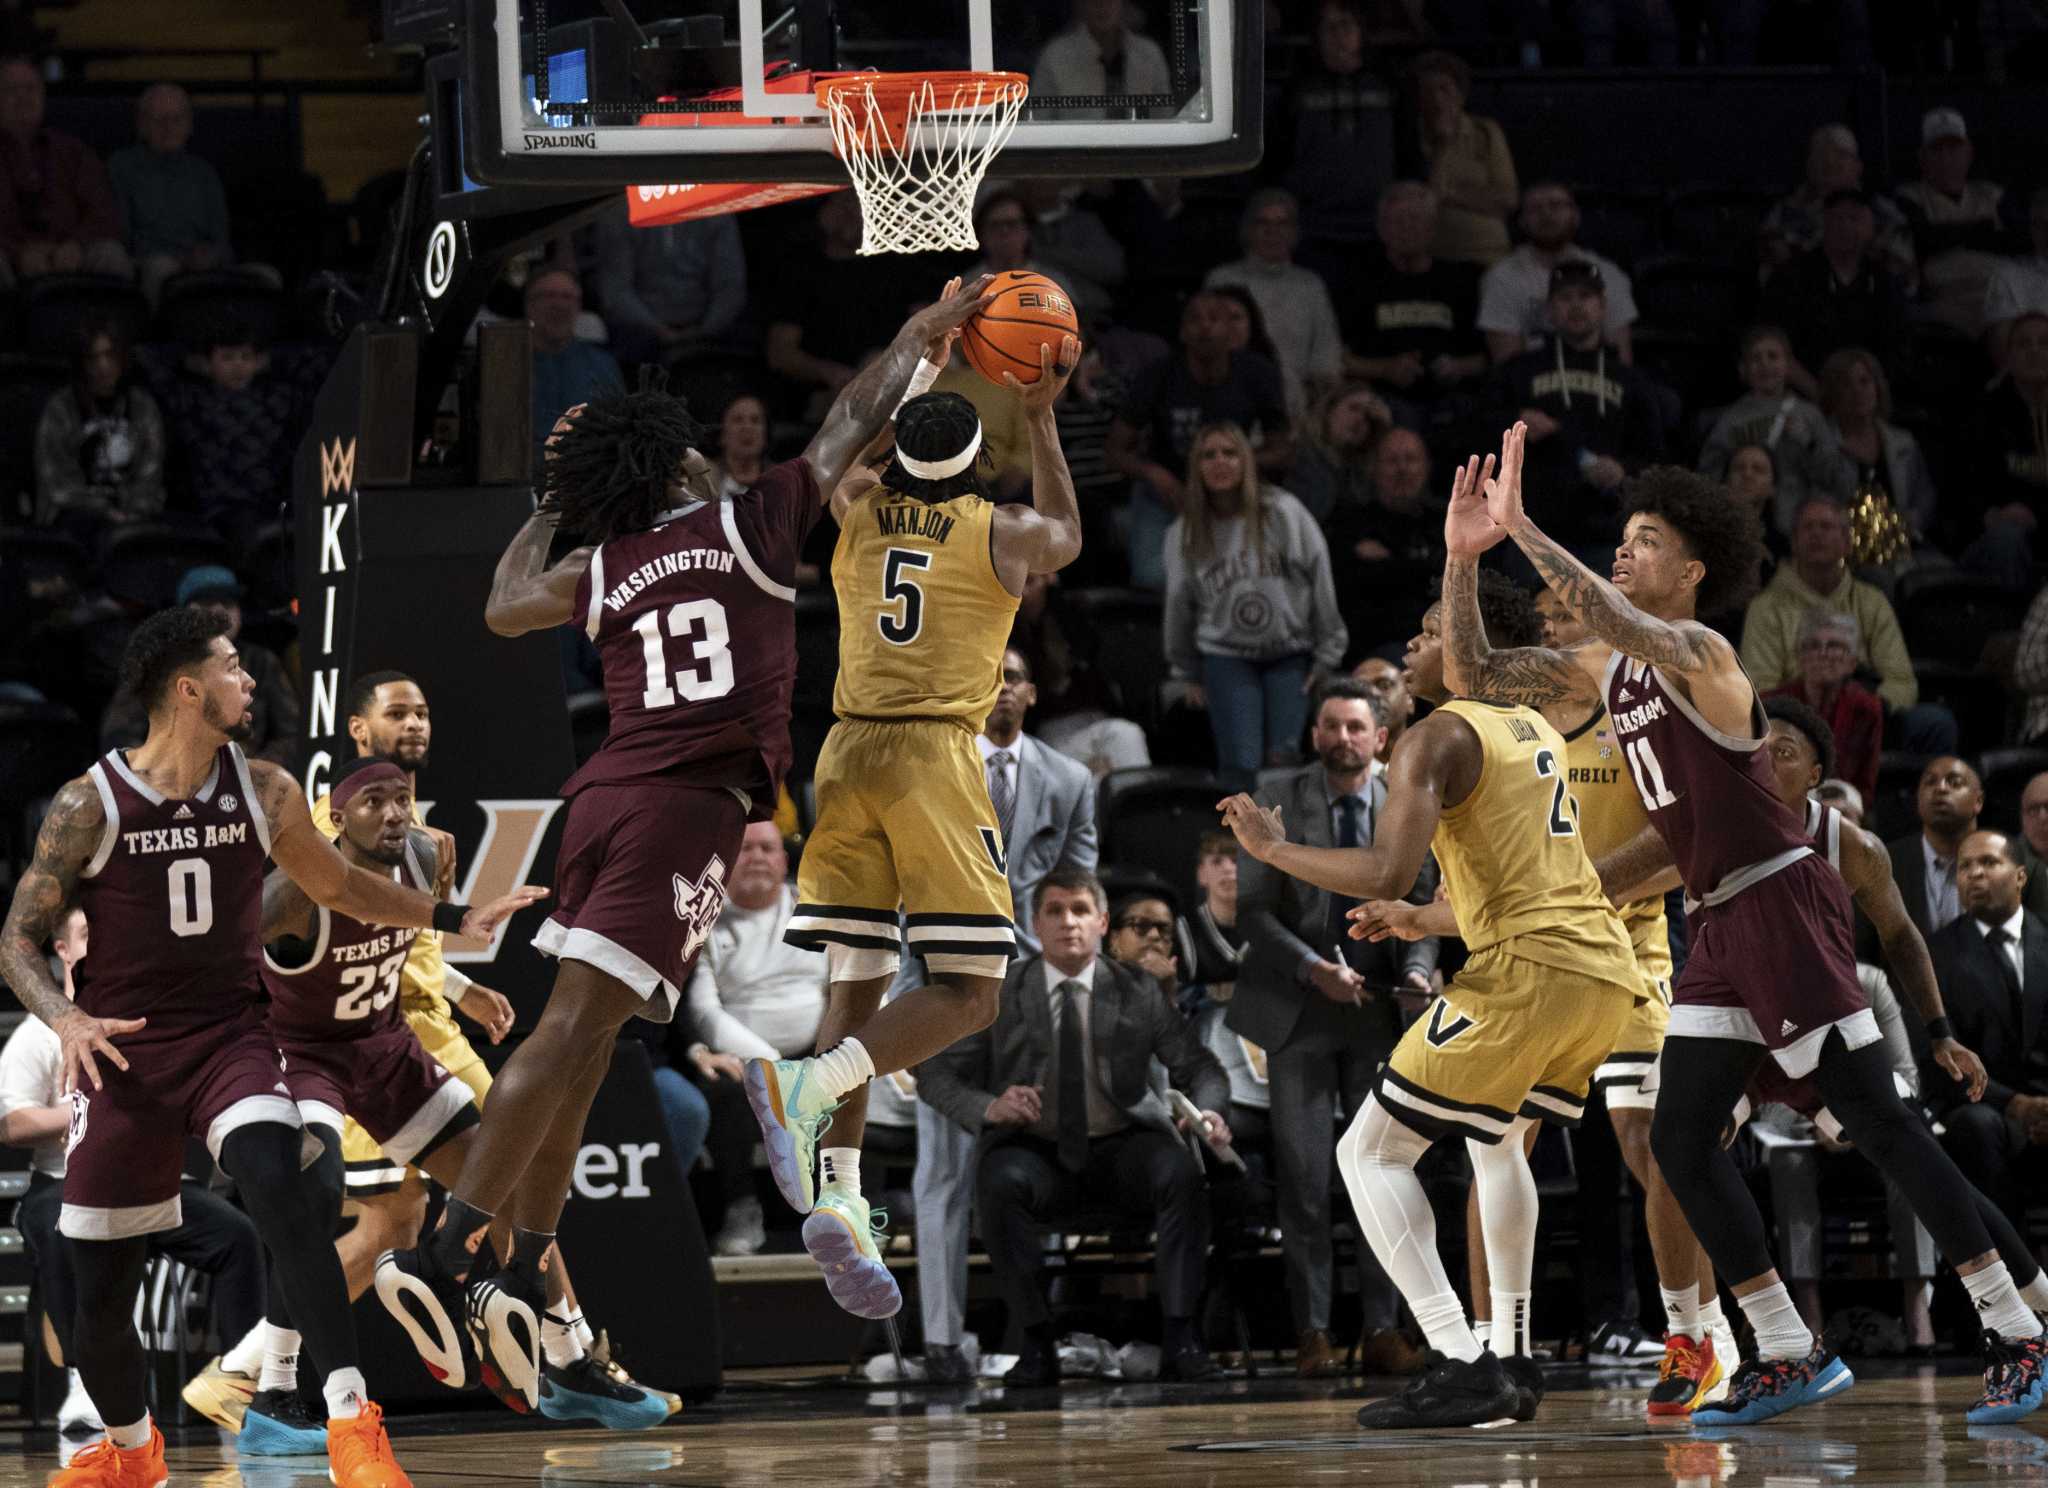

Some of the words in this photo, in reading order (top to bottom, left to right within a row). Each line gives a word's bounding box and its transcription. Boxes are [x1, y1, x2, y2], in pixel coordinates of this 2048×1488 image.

[524, 132, 598, 151] SPALDING
[876, 506, 956, 544] MANJON
[603, 548, 736, 612] WASHINGTON
[878, 547, 933, 646] 5
[632, 598, 735, 709] 13
[1535, 748, 1576, 836] 2
[1626, 736, 1677, 811] 11
[123, 827, 199, 855] TEXAS
[203, 822, 247, 848] A&M
[167, 857, 213, 937] 0
[332, 935, 391, 963] TEXAS
[334, 950, 407, 1020] 23
[566, 1142, 661, 1200] er
